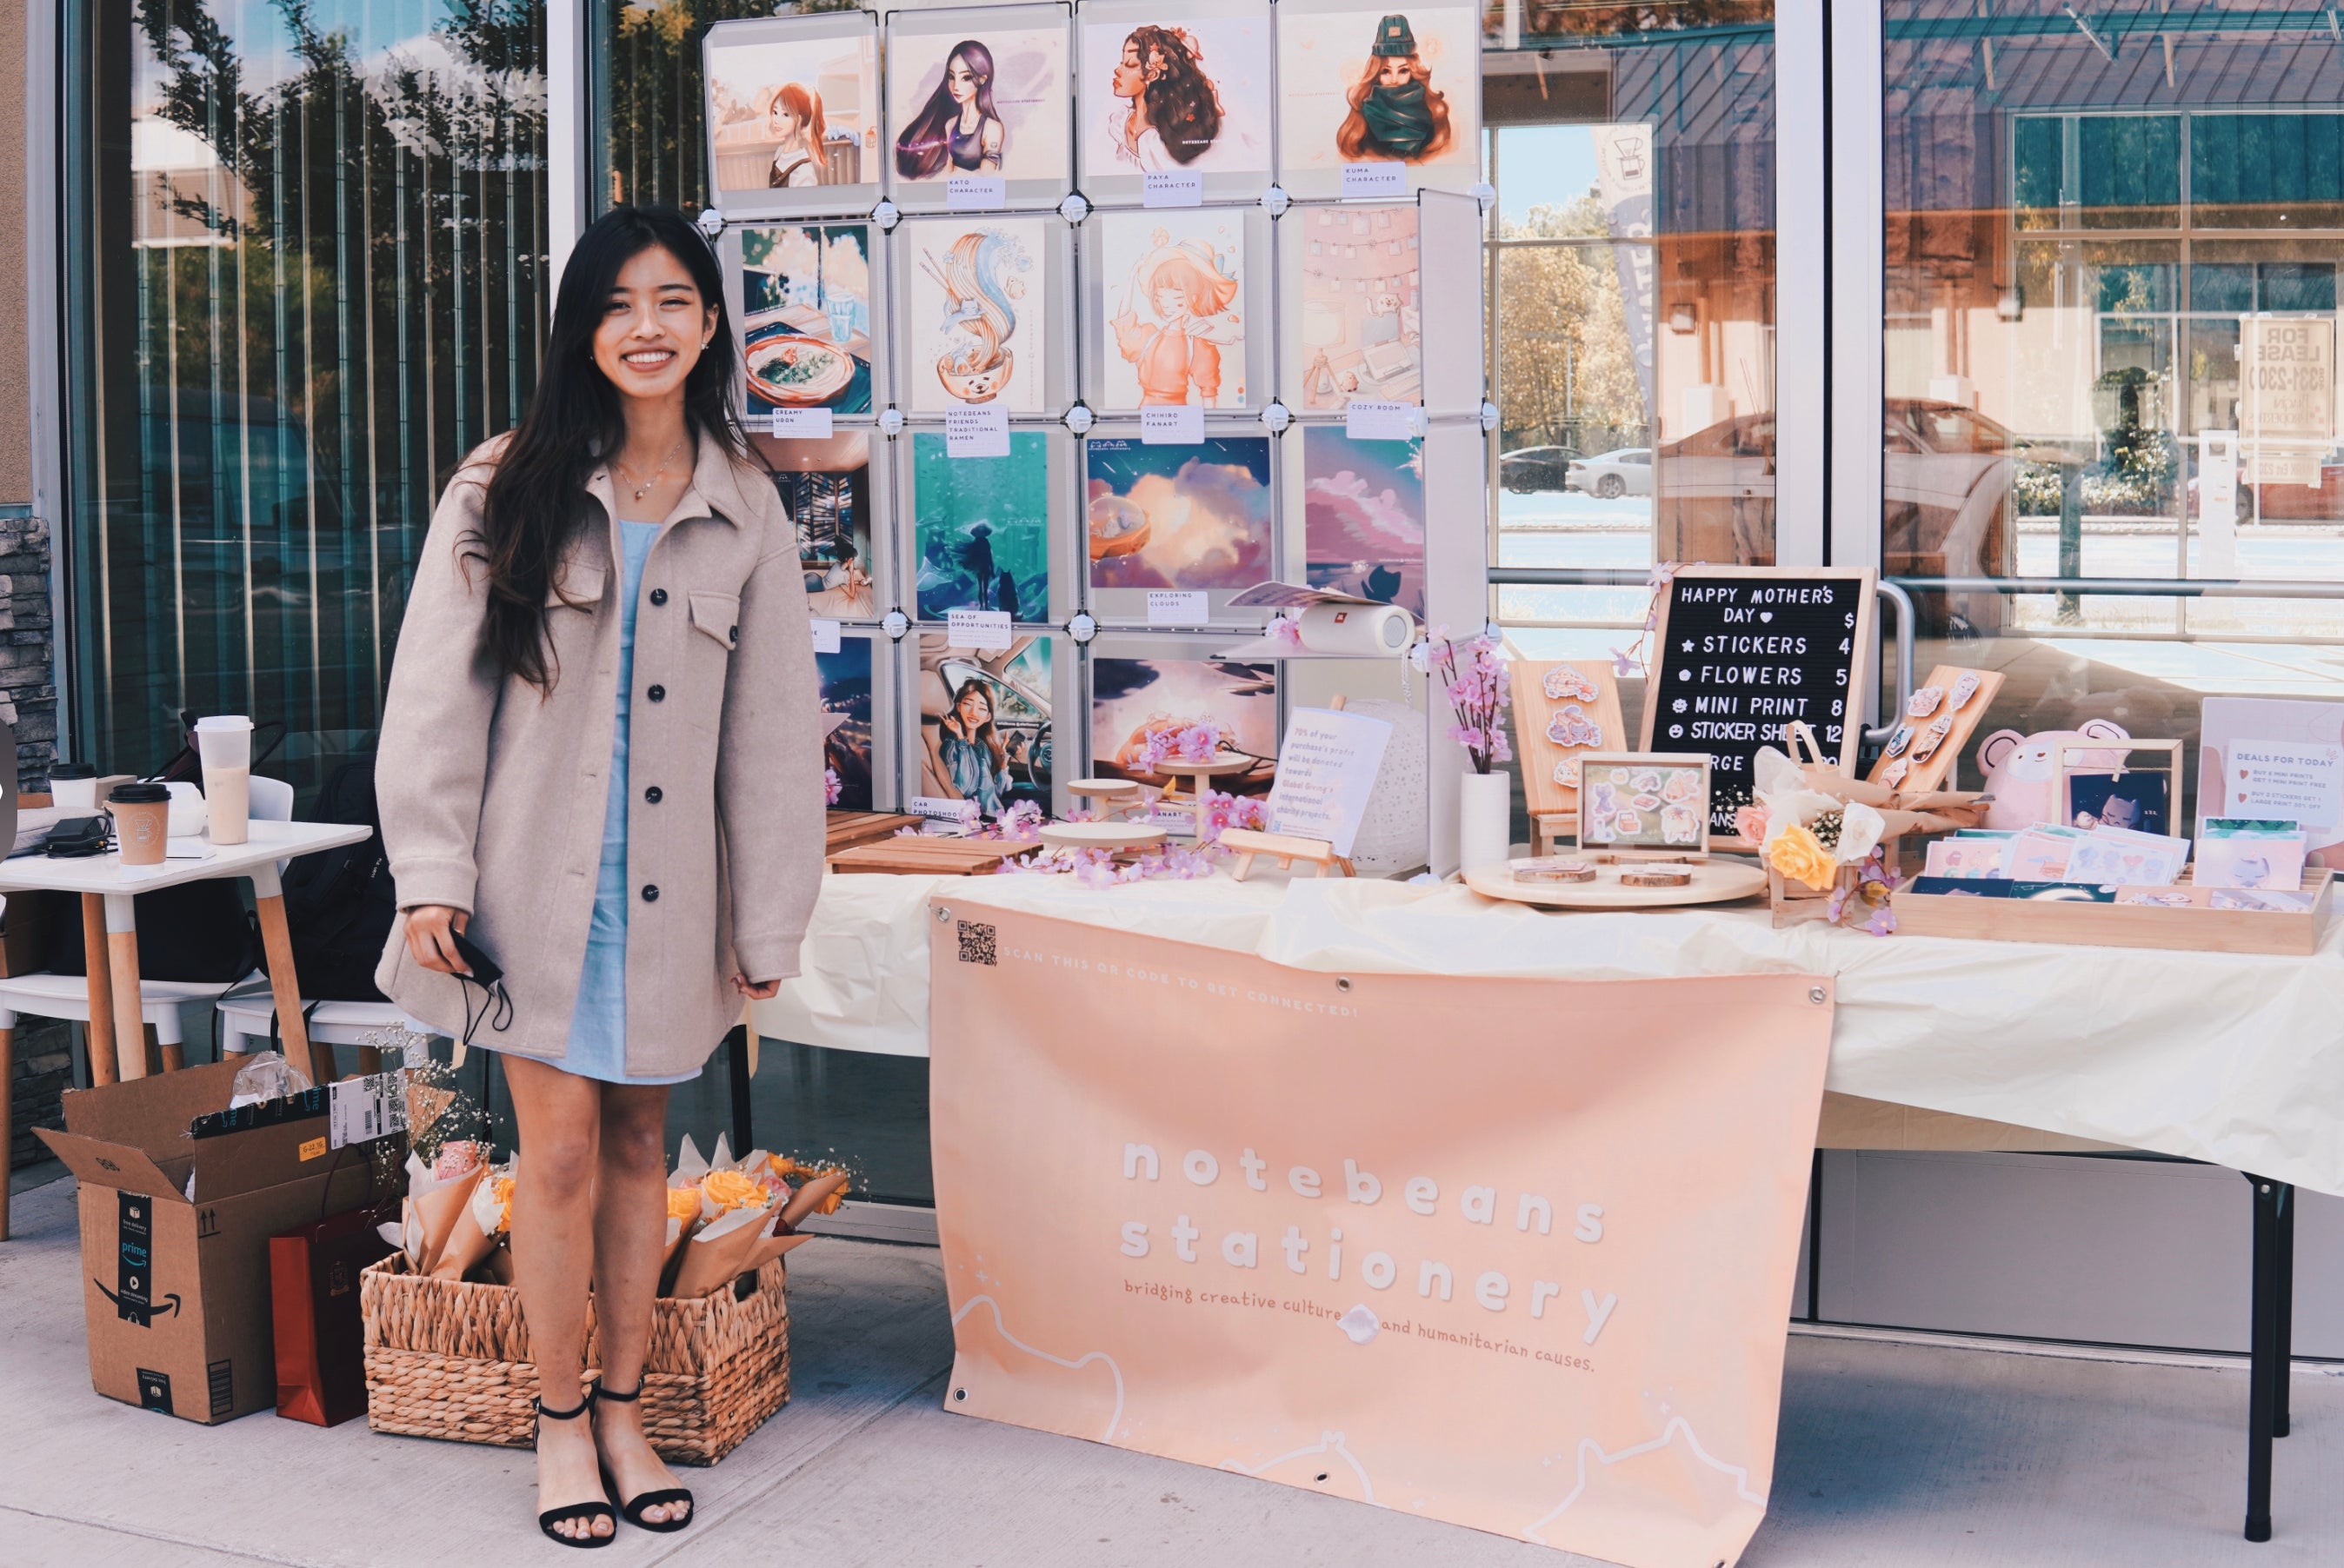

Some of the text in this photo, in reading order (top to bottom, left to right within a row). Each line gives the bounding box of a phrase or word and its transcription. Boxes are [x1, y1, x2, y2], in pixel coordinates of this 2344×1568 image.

[1681, 585, 1834, 604] HAPPY MOTHER'S
[1723, 608, 1755, 623] DAY
[1844, 612, 1855, 629] $
[1702, 635, 1850, 655] STICKERS 4
[1701, 666, 1848, 686] FLOWERS 5
[1695, 696, 1843, 717] MINI PRINT 8
[1690, 721, 1756, 741] STICKER
[1826, 725, 1842, 743] 12
[1710, 754, 1744, 771] RGE
[2237, 753, 2334, 767] DEALS FOR TODAY
[1003, 946, 1358, 1018] SCAN THIS QR CODE TO GET CONNECTED!
[1122, 1141, 1605, 1244] notebeans
[122, 1242, 147, 1258] prime
[1120, 1214, 1617, 1345] stationery
[1124, 1279, 1193, 1304] bridging
[1200, 1291, 1275, 1309] creative
[1382, 1320, 1411, 1334] and
[1418, 1324, 1528, 1358] humanitarian
[1535, 1349, 1595, 1372] causes.
